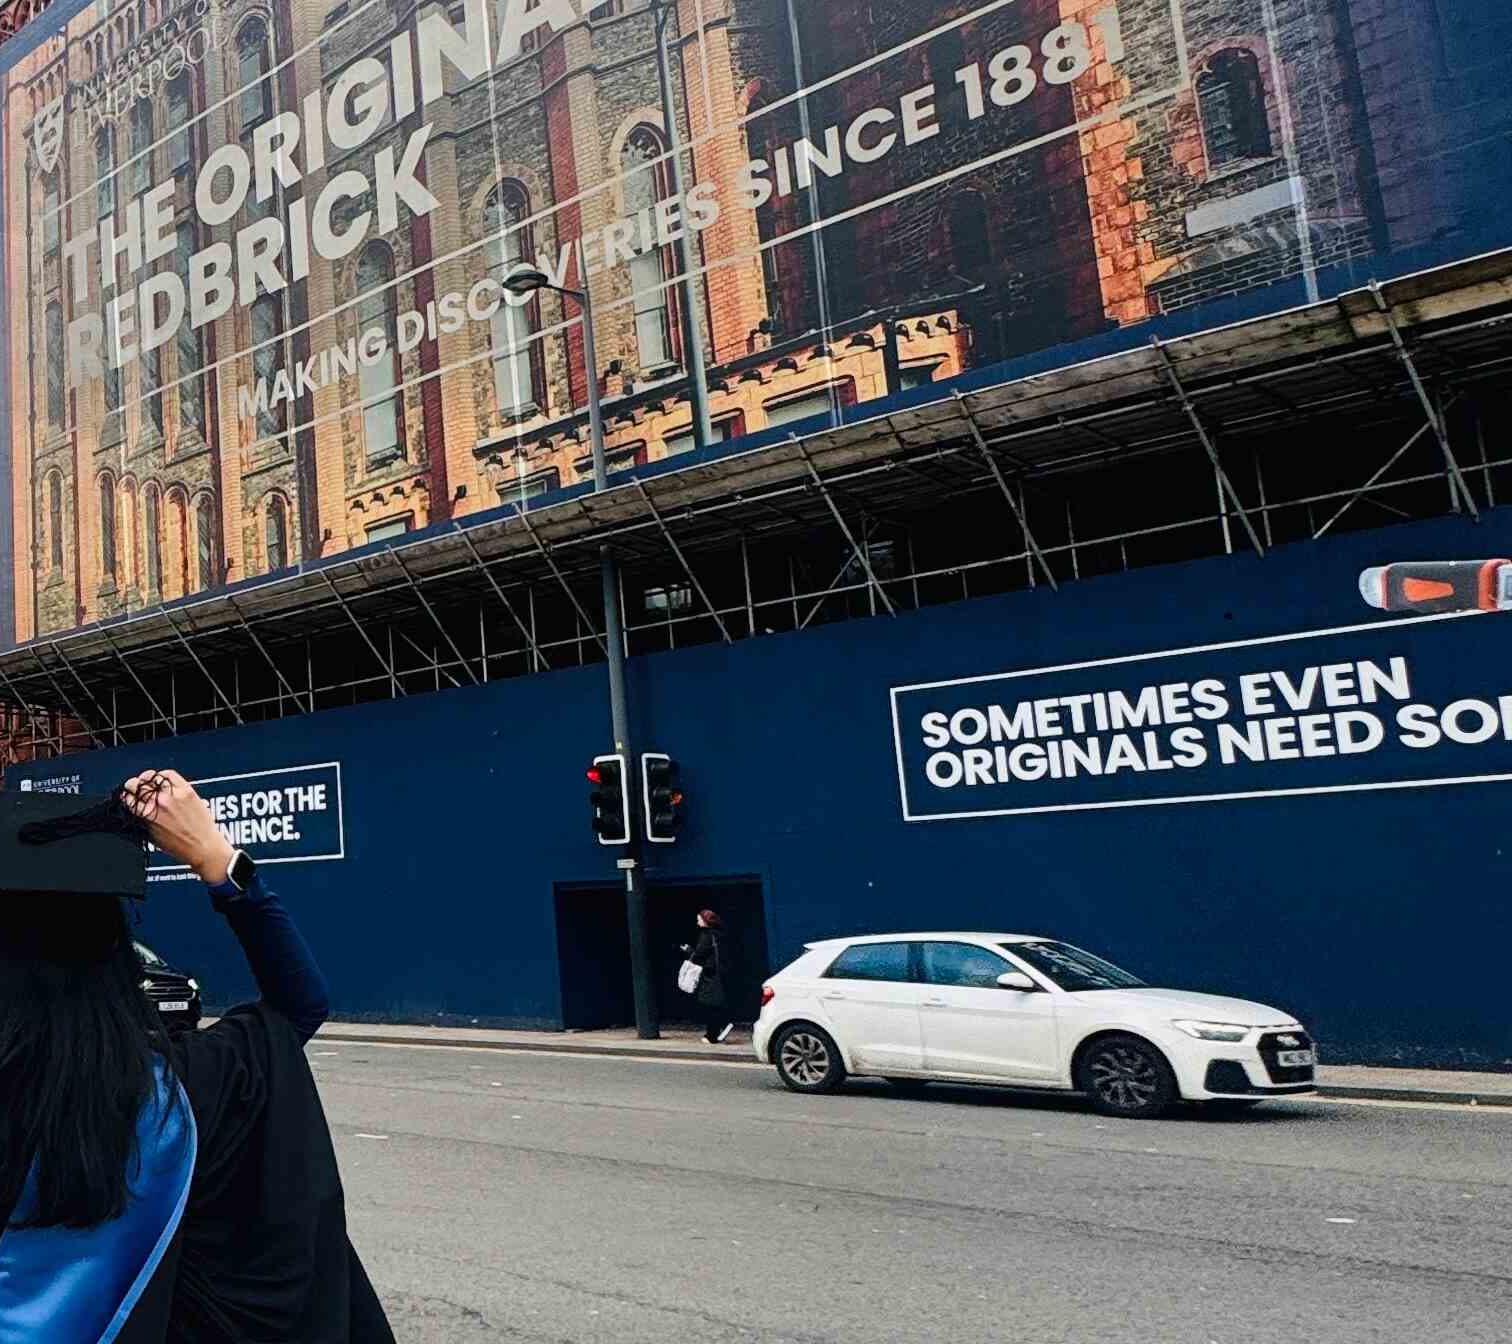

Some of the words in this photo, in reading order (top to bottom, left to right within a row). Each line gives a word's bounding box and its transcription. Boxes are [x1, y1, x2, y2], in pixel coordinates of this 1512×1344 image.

[62, 177, 178, 304] THE
[68, 123, 440, 389] REDBRICK
[239, 325, 388, 417] MAKING
[737, 84, 940, 209] SINCE
[921, 679, 1226, 748] SOMETIMES
[1240, 657, 1410, 716] EVEN
[925, 725, 1207, 788] ORIGINALS
[1218, 710, 1384, 765] NEED
[217, 814, 301, 846] NIENCE.
[241, 789, 282, 817] FOR
[284, 783, 327, 813] THE
